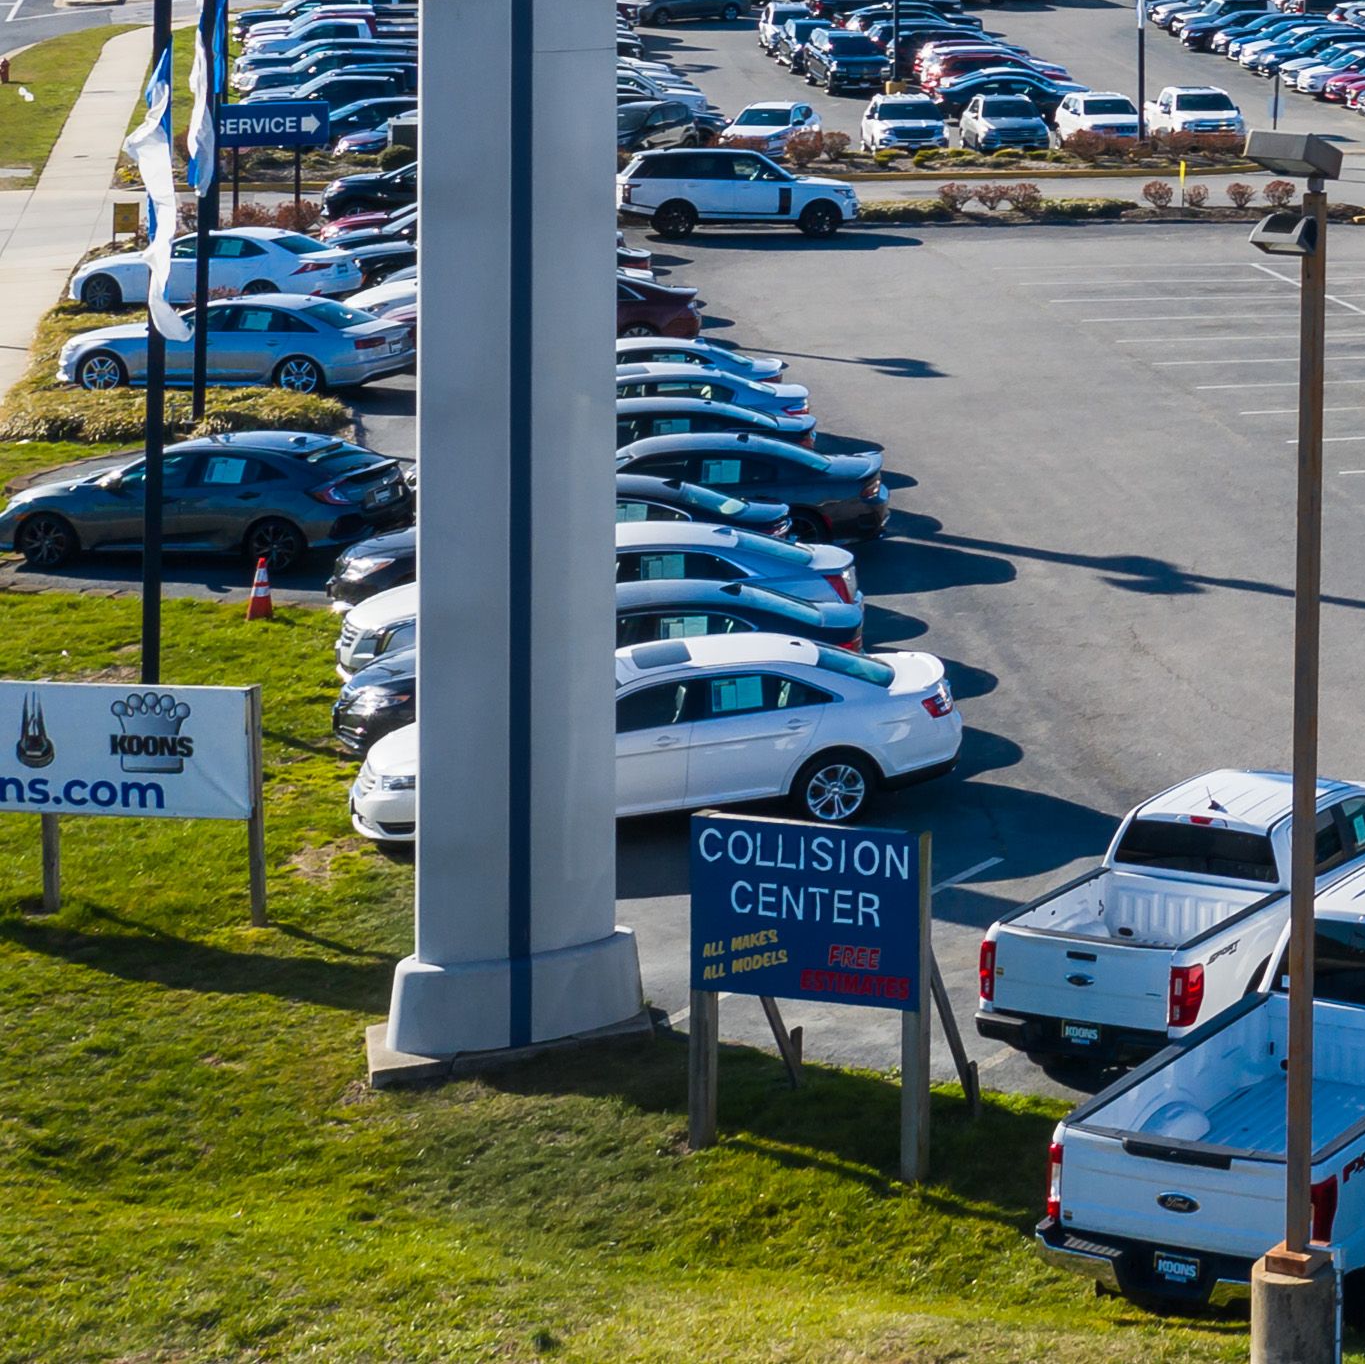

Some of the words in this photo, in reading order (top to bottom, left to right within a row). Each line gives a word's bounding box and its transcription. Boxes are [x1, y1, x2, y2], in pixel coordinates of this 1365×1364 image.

[110, 734, 194, 758] KOONS
[699, 828, 909, 880] COLLISION
[731, 880, 880, 927] CENTER
[703, 941, 725, 958] ALL
[731, 929, 779, 952] MAKES
[828, 944, 881, 970] FREE
[703, 963, 726, 980] ALL
[731, 949, 789, 974] MODELS
[800, 968, 911, 1001] ESTIMATES
[1065, 1025, 1098, 1040] KOONS
[1157, 1258, 1197, 1277] KOONS
